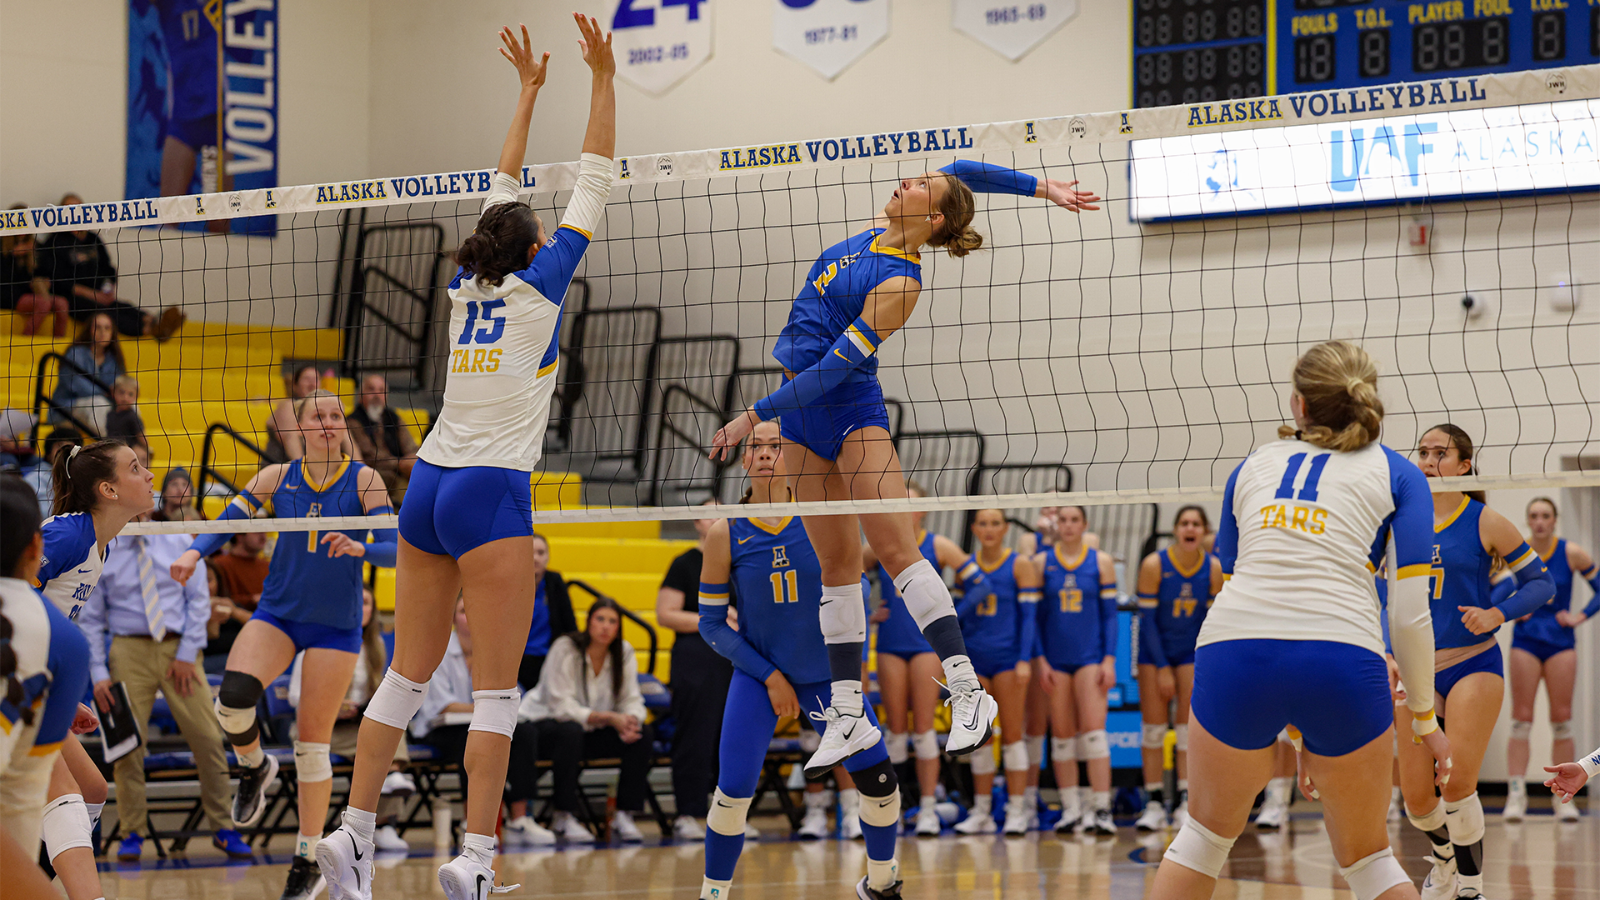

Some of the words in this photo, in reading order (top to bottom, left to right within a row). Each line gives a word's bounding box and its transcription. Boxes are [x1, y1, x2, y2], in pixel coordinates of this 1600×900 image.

[1291, 12, 1339, 36] FOULS
[1354, 8, 1394, 29] T.O.L.
[1408, 1, 1465, 25] PLAYER
[1187, 99, 1283, 127] ALASKA
[1288, 78, 1487, 119] VOLLEYBALL
[719, 143, 803, 171] ALASKA
[805, 127, 973, 163] VOLLEYBALL
[1331, 122, 1438, 192] UAF
[1451, 130, 1593, 163] ALASKA
[315, 180, 388, 204] ALASKA
[390, 167, 536, 199] VOLLEYBL
[30, 200, 158, 229] VOLLEYBALL
[457, 297, 507, 345] 15
[451, 347, 504, 374] TARS
[1273, 452, 1333, 503] 11
[1260, 504, 1329, 535] TARS
[769, 569, 799, 604] 11
[1058, 588, 1083, 613] 12
